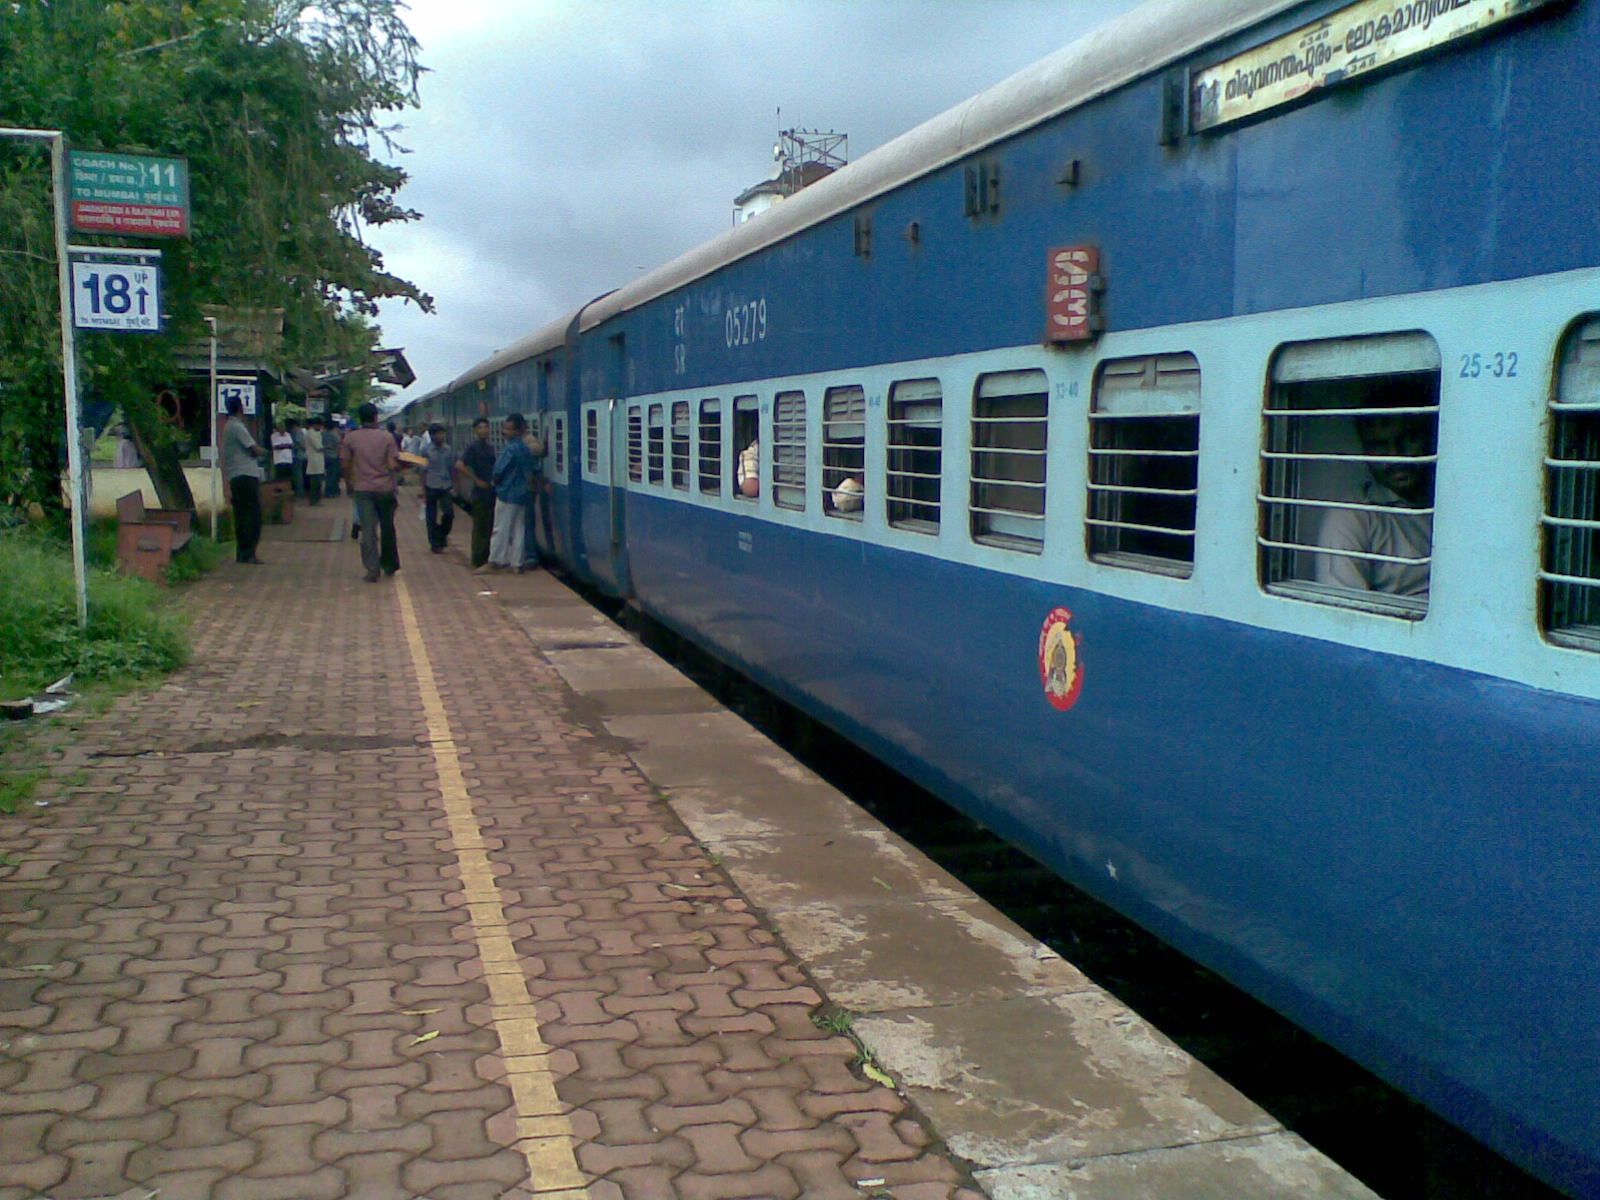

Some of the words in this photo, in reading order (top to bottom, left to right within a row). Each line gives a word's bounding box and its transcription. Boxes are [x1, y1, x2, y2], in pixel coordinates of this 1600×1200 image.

[73, 158, 116, 169] COACH
[149, 163, 176, 187] 11
[77, 187, 92, 197] TO
[94, 189, 139, 200] MUMBAI
[134, 272, 149, 284] UP
[82, 273, 132, 314] 18
[725, 298, 767, 348] 05279
[1460, 351, 1518, 378] 25-32
